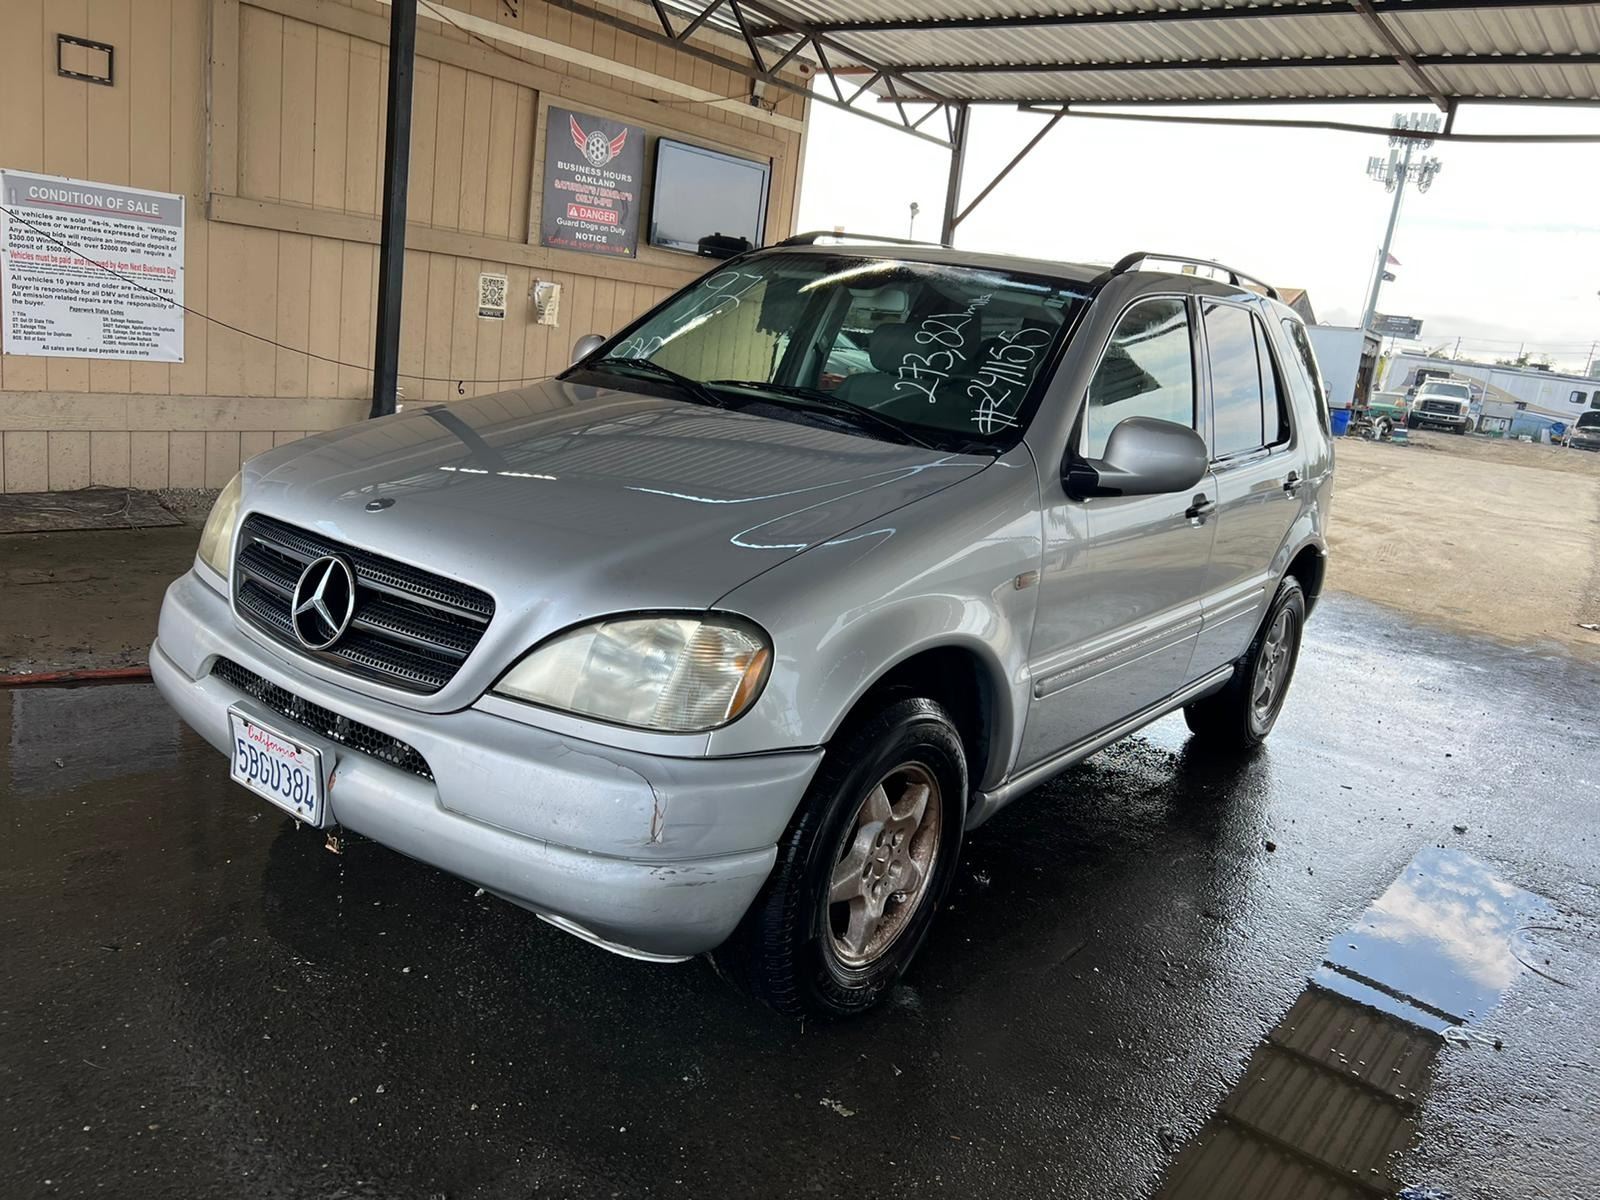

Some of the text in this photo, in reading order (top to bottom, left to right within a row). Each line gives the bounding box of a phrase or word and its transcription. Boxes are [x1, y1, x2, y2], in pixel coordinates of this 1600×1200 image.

[558, 161, 632, 182] BUSINESS HOURS
[575, 175, 615, 188] OAKLAND
[29, 186, 160, 215] CONDITION OF SALE
[22, 211, 53, 220] vehicles
[580, 208, 616, 222] DANGER
[64, 224, 101, 233] warranties
[103, 229, 139, 238] expressed
[556, 217, 579, 226] Guard
[580, 221, 598, 230] Dogs
[610, 226, 626, 235] Duty
[114, 238, 146, 247] immediate
[147, 242, 169, 250] deposit
[549, 236, 568, 245] Enter
[576, 232, 607, 242] NOTICE
[36, 237, 63, 246] Winng
[100, 244, 127, 253] $2000.00
[10, 250, 34, 260] Vehicles
[36, 253, 49, 262] must
[59, 256, 71, 264] paid
[143, 264, 165, 274] Business
[167, 267, 176, 276] Day
[41, 286, 79, 294] responsible
[127, 301, 167, 310] responsibility
[247, 723, 303, 764] California
[237, 738, 314, 812] 5BGU384
